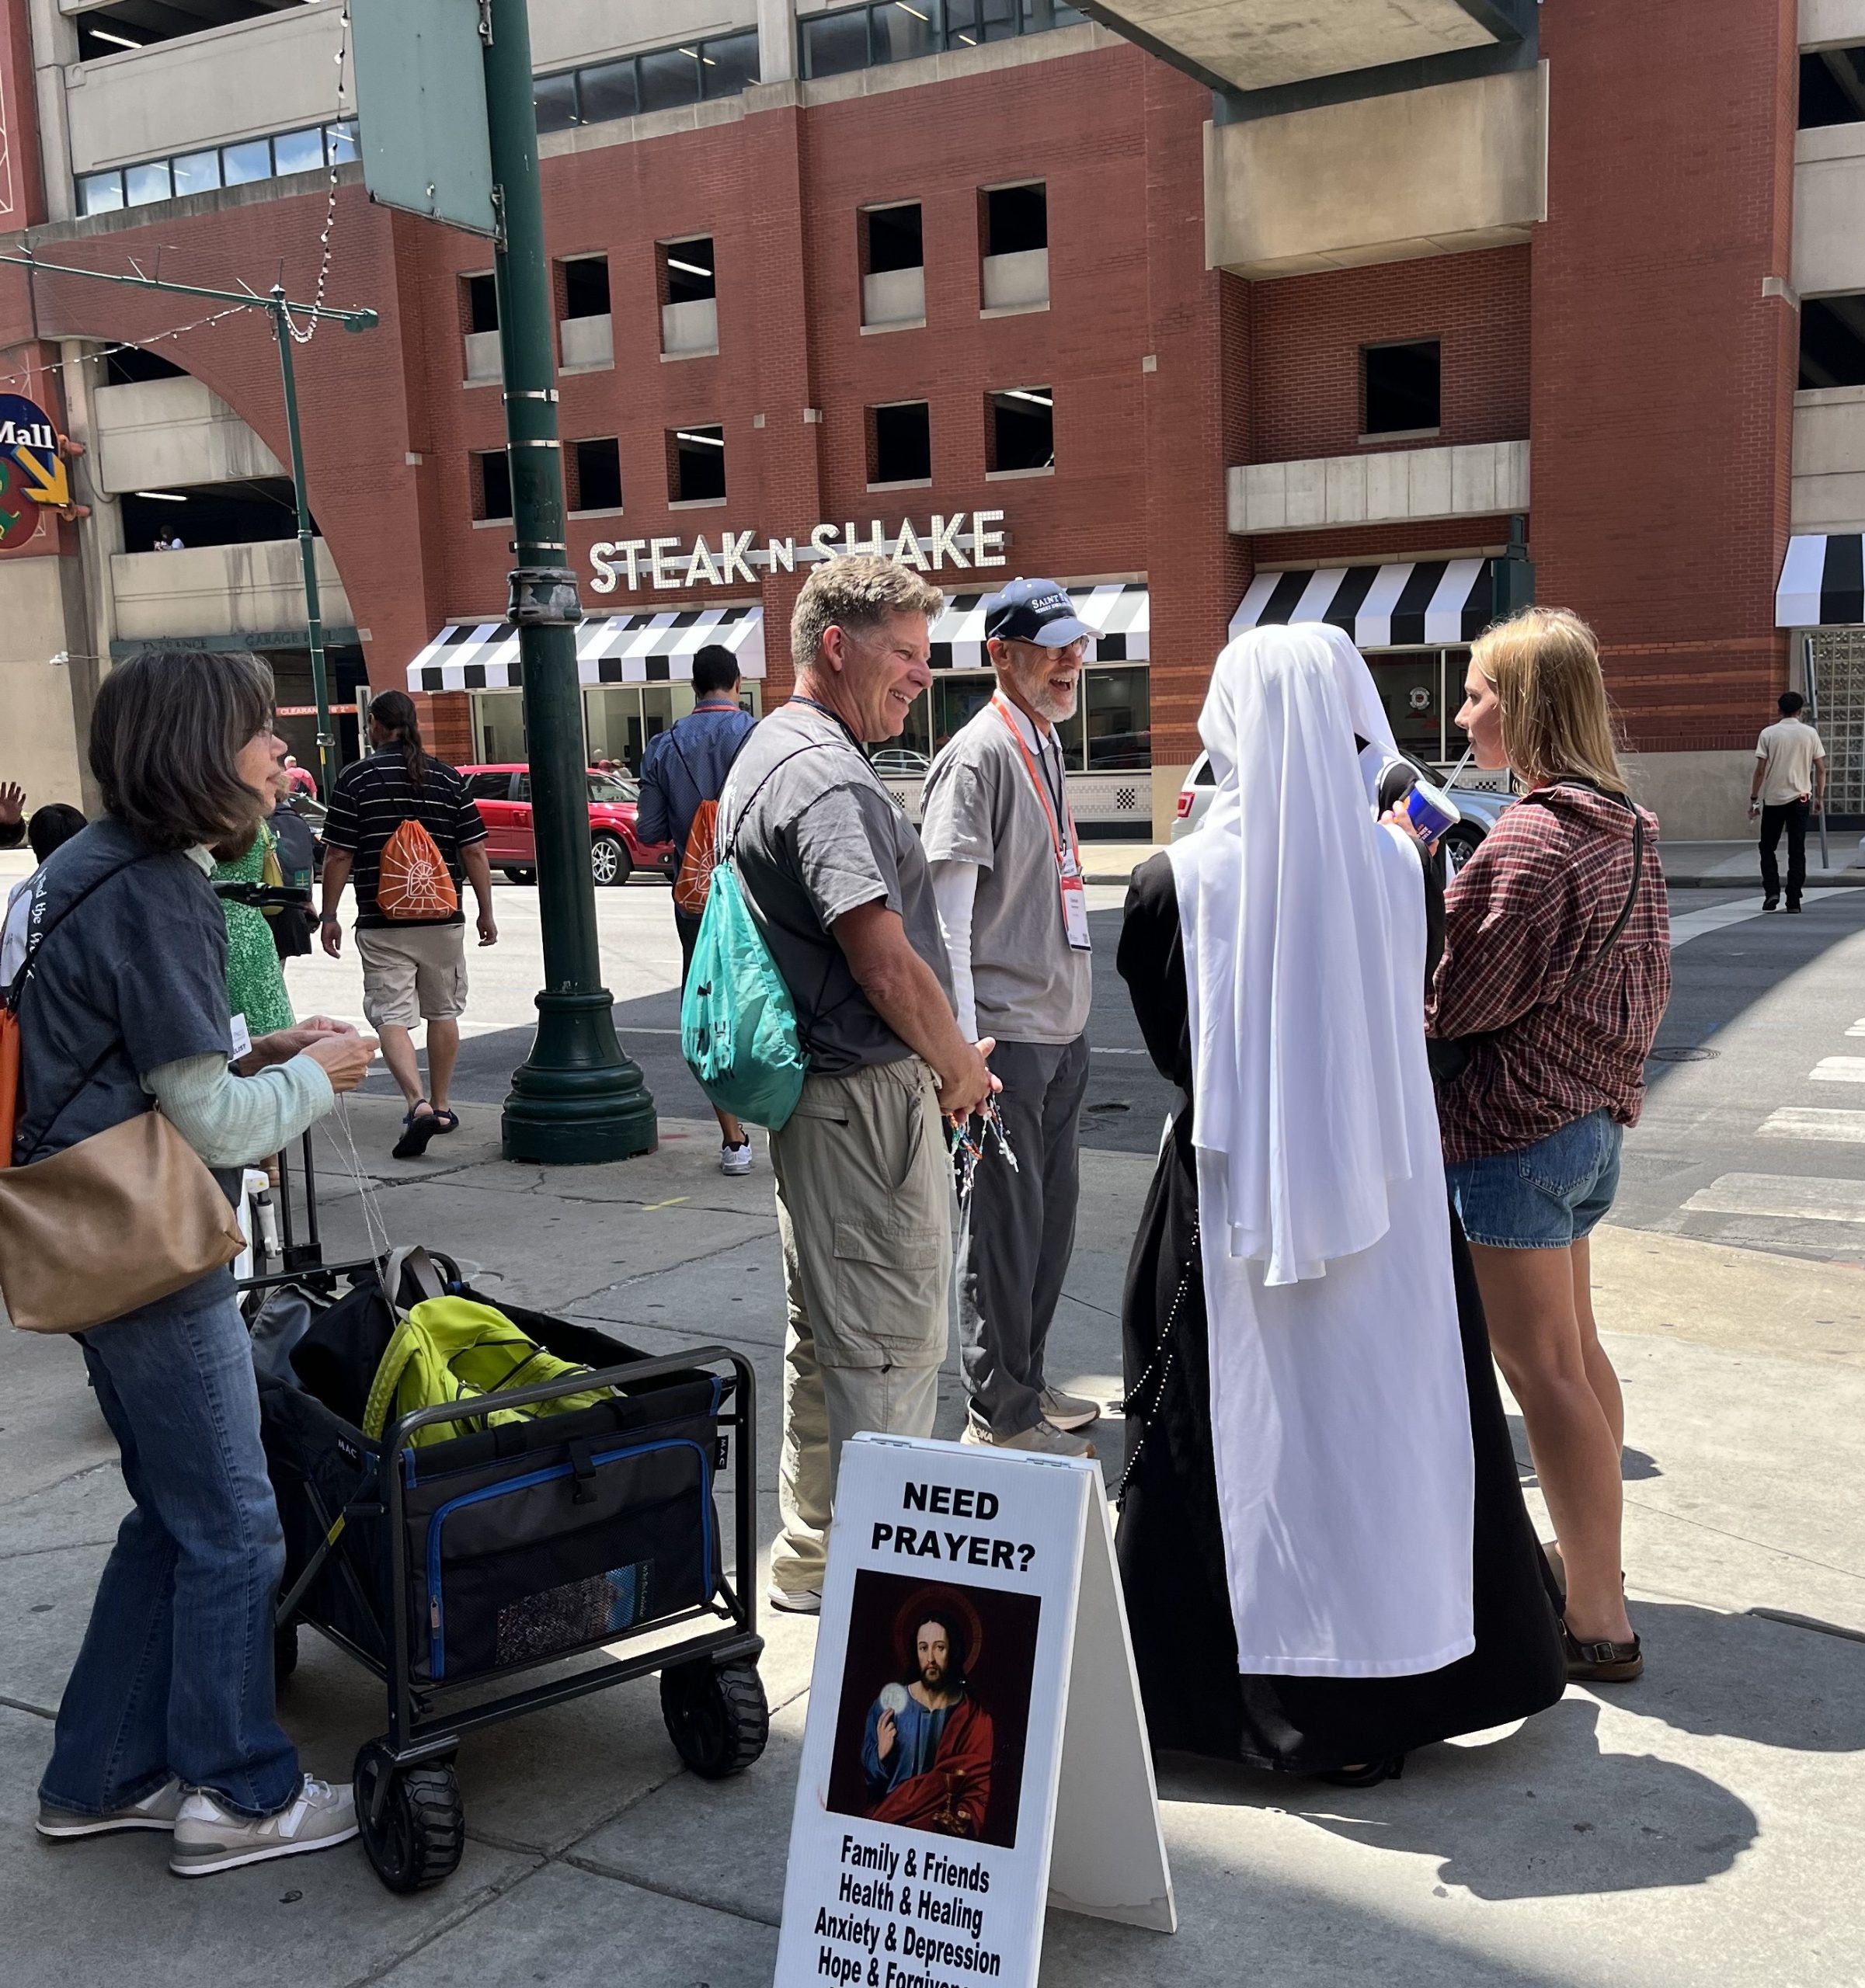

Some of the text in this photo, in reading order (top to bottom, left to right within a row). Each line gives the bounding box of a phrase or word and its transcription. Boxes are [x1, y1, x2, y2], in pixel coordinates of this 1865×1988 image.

[0, 421, 54, 449] Mall
[590, 510, 1006, 594] STEAK N SHAKE
[245, 628, 299, 646] GARAGE
[31, 902, 47, 924] the
[338, 1439, 357, 1458] MAC
[903, 1482, 999, 1520] NEED
[872, 1522, 1035, 1572] PRAYER?
[840, 1834, 990, 1893] Family & Friends
[839, 1873, 983, 1939] Health & Healing
[814, 1906, 1000, 1976] Anxiety & Depression
[818, 1945, 861, 1986] Hope
[867, 1957, 879, 1987] &
